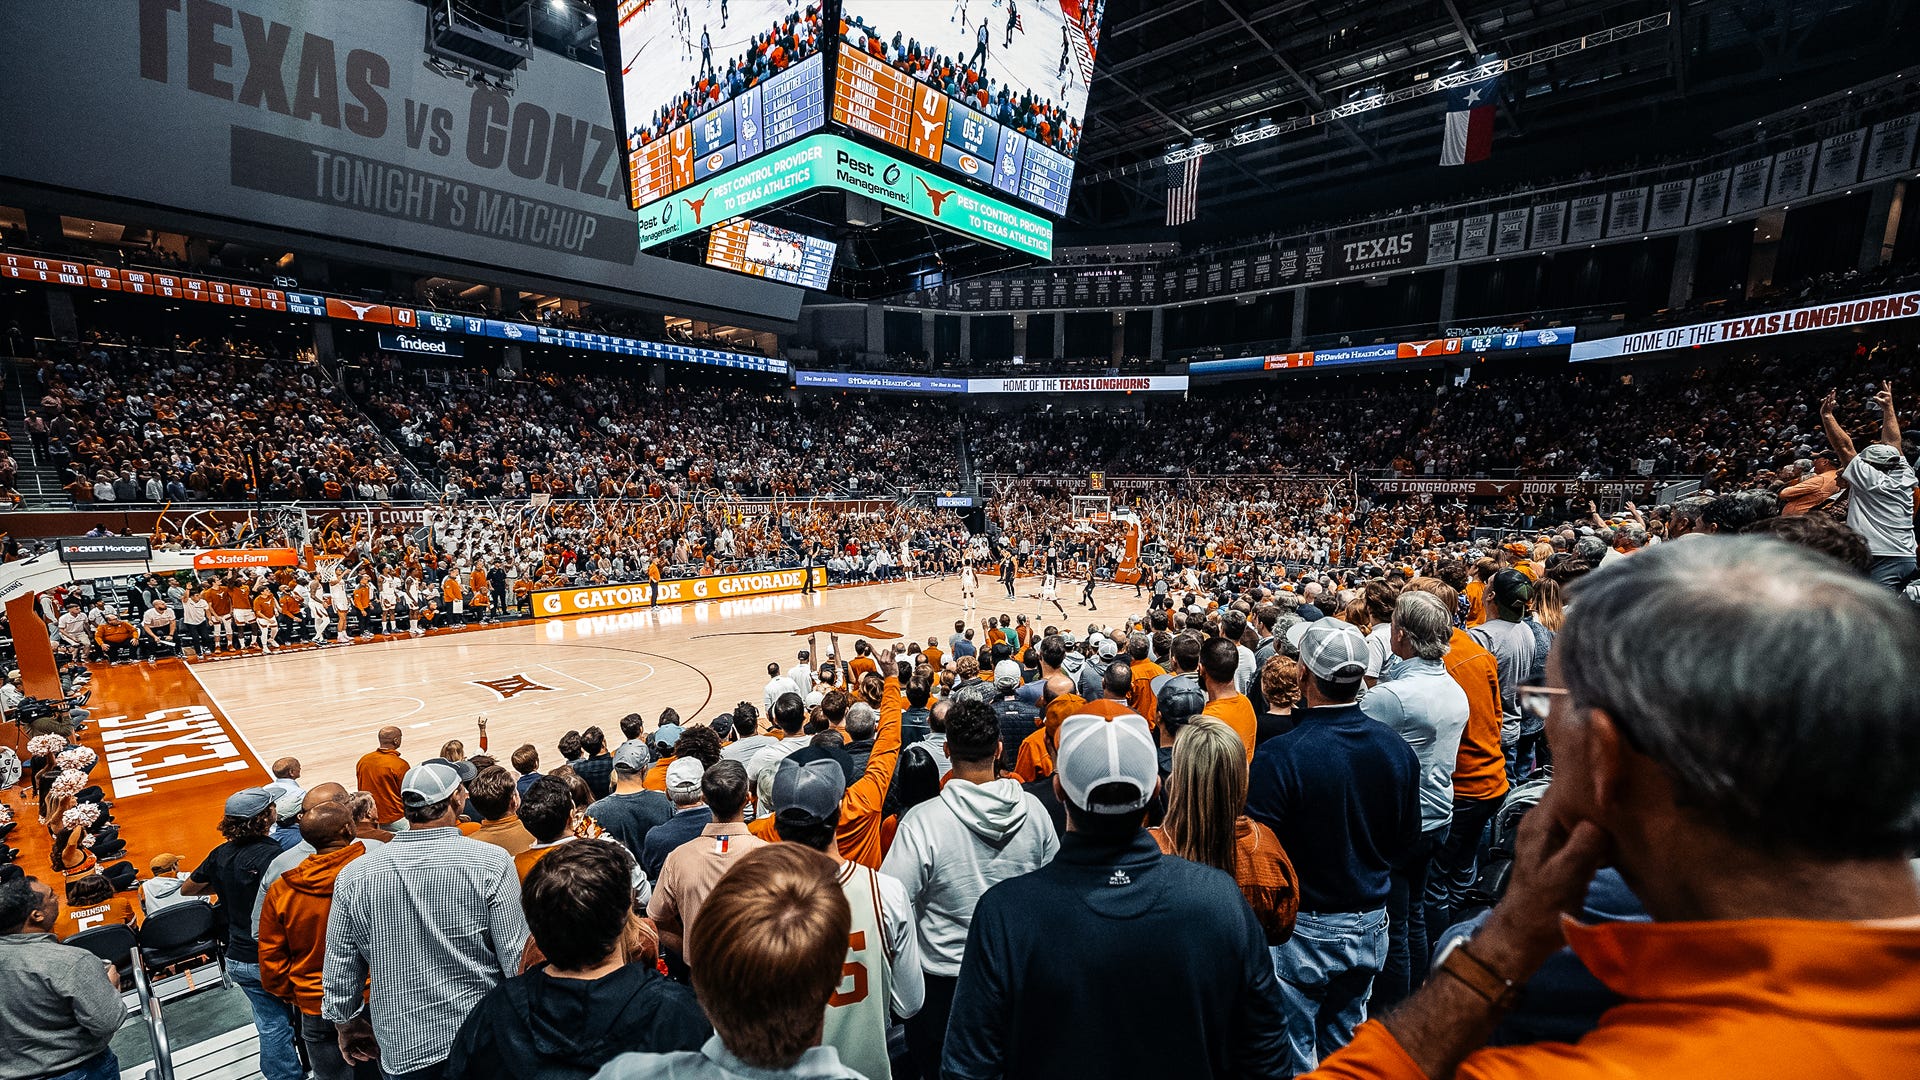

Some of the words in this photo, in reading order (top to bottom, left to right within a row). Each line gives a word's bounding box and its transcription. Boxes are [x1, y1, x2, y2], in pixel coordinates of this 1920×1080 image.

[139, 0, 390, 139] TEXAS
[405, 99, 453, 156] VS
[741, 90, 754, 119] 37
[923, 88, 940, 117] 47
[704, 118, 722, 143] 05.3
[962, 118, 985, 145] 05.3
[1005, 130, 1019, 156] 37
[837, 150, 875, 177] Pest
[713, 183, 732, 199] PEST
[733, 168, 773, 191] CONTROL
[774, 146, 823, 174] PROVIDER
[724, 197, 735, 211] TO
[736, 186, 763, 207] TEXAS
[763, 168, 811, 198] ATHLETICS
[837, 169, 906, 204] Management
[312, 149, 467, 227] TONIGHT'S
[474, 189, 597, 252] MATCHUP
[956, 194, 979, 212] PEST
[980, 202, 1019, 228] CONTROL
[639, 216, 658, 231] Pest
[969, 215, 981, 229] TO
[982, 221, 1008, 240] TEXAS
[1009, 231, 1049, 252] ATHLETICS
[1343, 233, 1413, 262] TEXAS
[7, 256, 17, 266] FT
[34, 260, 48, 270] FTA
[62, 264, 78, 274] FT%
[1350, 258, 1401, 270] BASKETBALL
[11, 267, 18, 277] 6
[40, 271, 47, 281] 6
[58, 273, 84, 285] 100.0
[160, 277, 174, 287] REB
[101, 279, 108, 288] 3
[133, 283, 143, 293] 10
[188, 281, 201, 290] AST
[214, 284, 224, 293] TO
[163, 287, 173, 296] 13
[193, 291, 198, 299] 7
[239, 288, 252, 297] BLK
[267, 292, 279, 301] STL
[244, 298, 251, 306] 2
[271, 301, 277, 310] 4
[290, 295, 301, 304] TOL
[313, 297, 319, 306] 3
[290, 304, 311, 314] FOULS
[313, 307, 322, 315] 10
[398, 310, 411, 324] 47
[430, 316, 452, 329] 05.2
[1622, 333, 1663, 354] HOME
[1666, 328, 1685, 348] OF
[1688, 323, 1716, 344] THE
[1721, 315, 1783, 341] TEXAS
[1782, 294, 1920, 332] LONGHORNS
[469, 319, 481, 333] 37
[397, 334, 446, 353] indeed
[1446, 340, 1458, 351] 47
[1471, 338, 1491, 349] 05.2
[1505, 334, 1519, 346] 37
[1003, 380, 1028, 392] HOME
[1029, 380, 1040, 391] OF
[1041, 379, 1058, 391] THE
[1059, 378, 1090, 391] TEXAS
[1091, 377, 1150, 390] LONGHORNS
[1401, 482, 1476, 493] LONGHORNS
[1522, 482, 1556, 494] HOOK
[63, 545, 104, 553] ROCKET
[105, 545, 147, 553] Mortgage
[543, 594, 560, 613] G
[694, 580, 708, 597] G
[719, 572, 801, 594] GATORADE
[98, 705, 249, 799] TEXAS
[70, 904, 111, 920] ROBINSON
